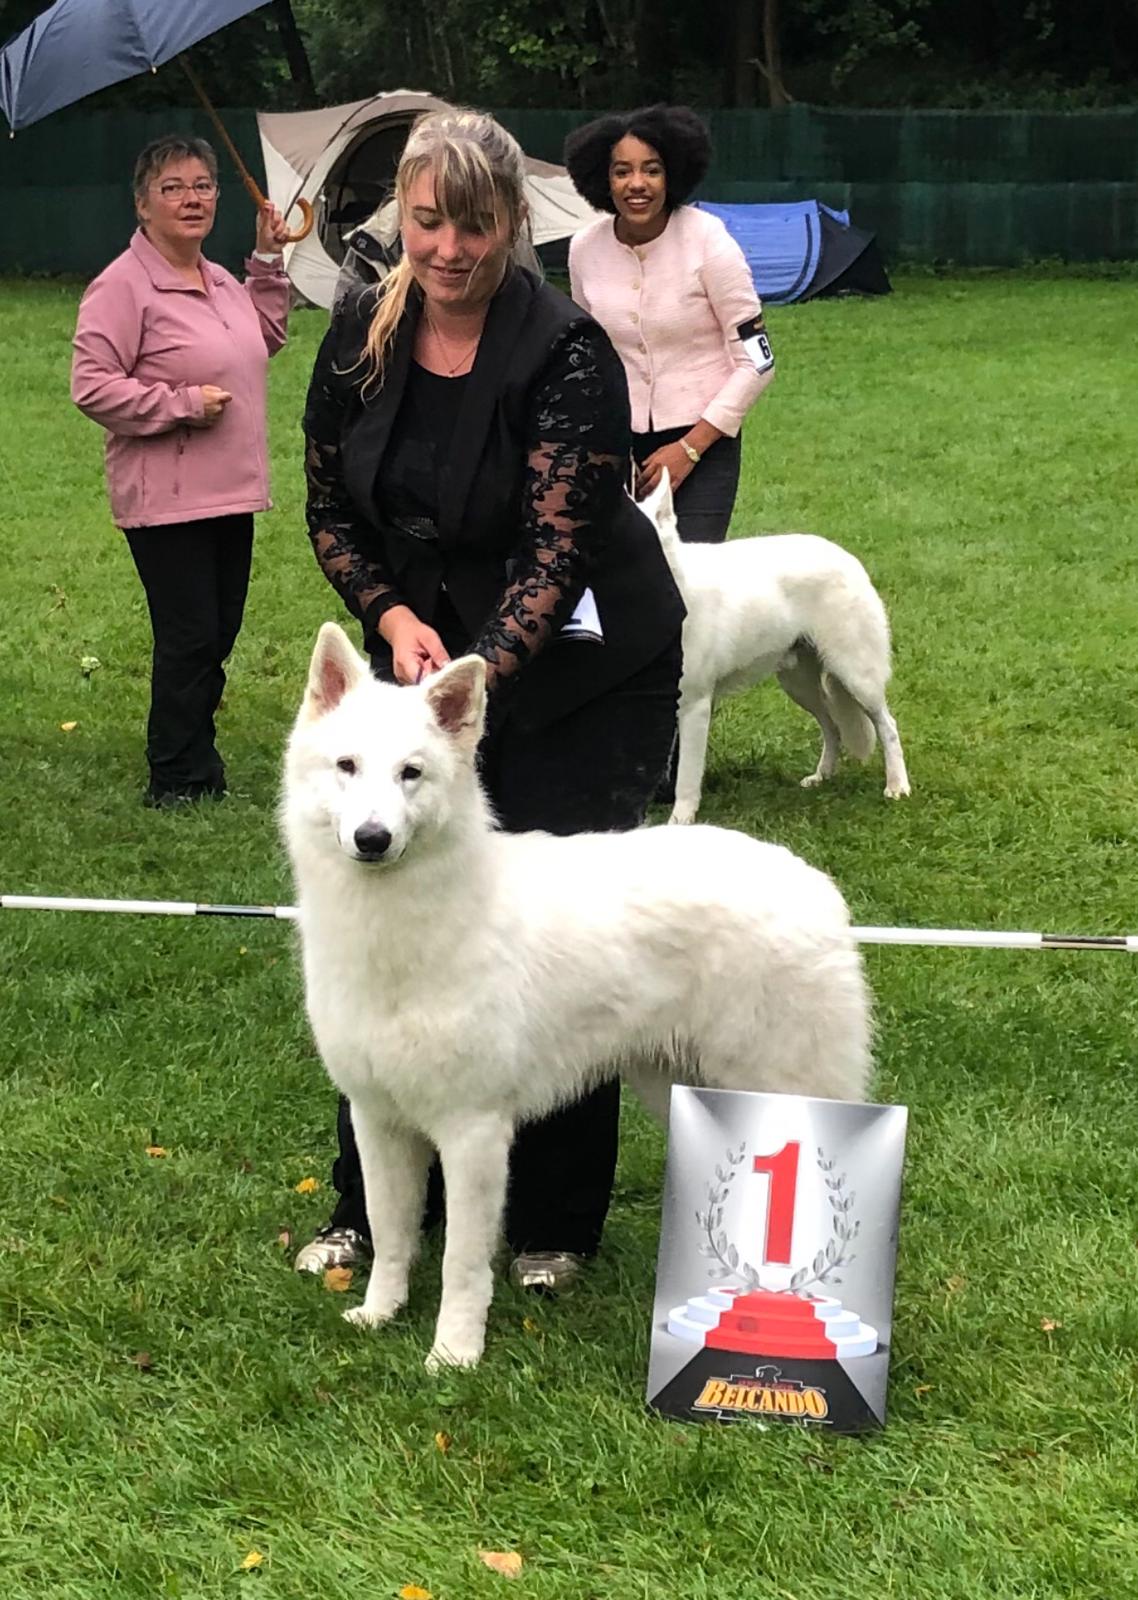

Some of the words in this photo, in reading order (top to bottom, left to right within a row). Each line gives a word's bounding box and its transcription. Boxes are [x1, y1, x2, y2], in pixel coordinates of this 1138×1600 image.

[757, 336, 771, 361] 6
[752, 1139, 801, 1268] 1
[695, 1380, 828, 1419] BELCANDO
